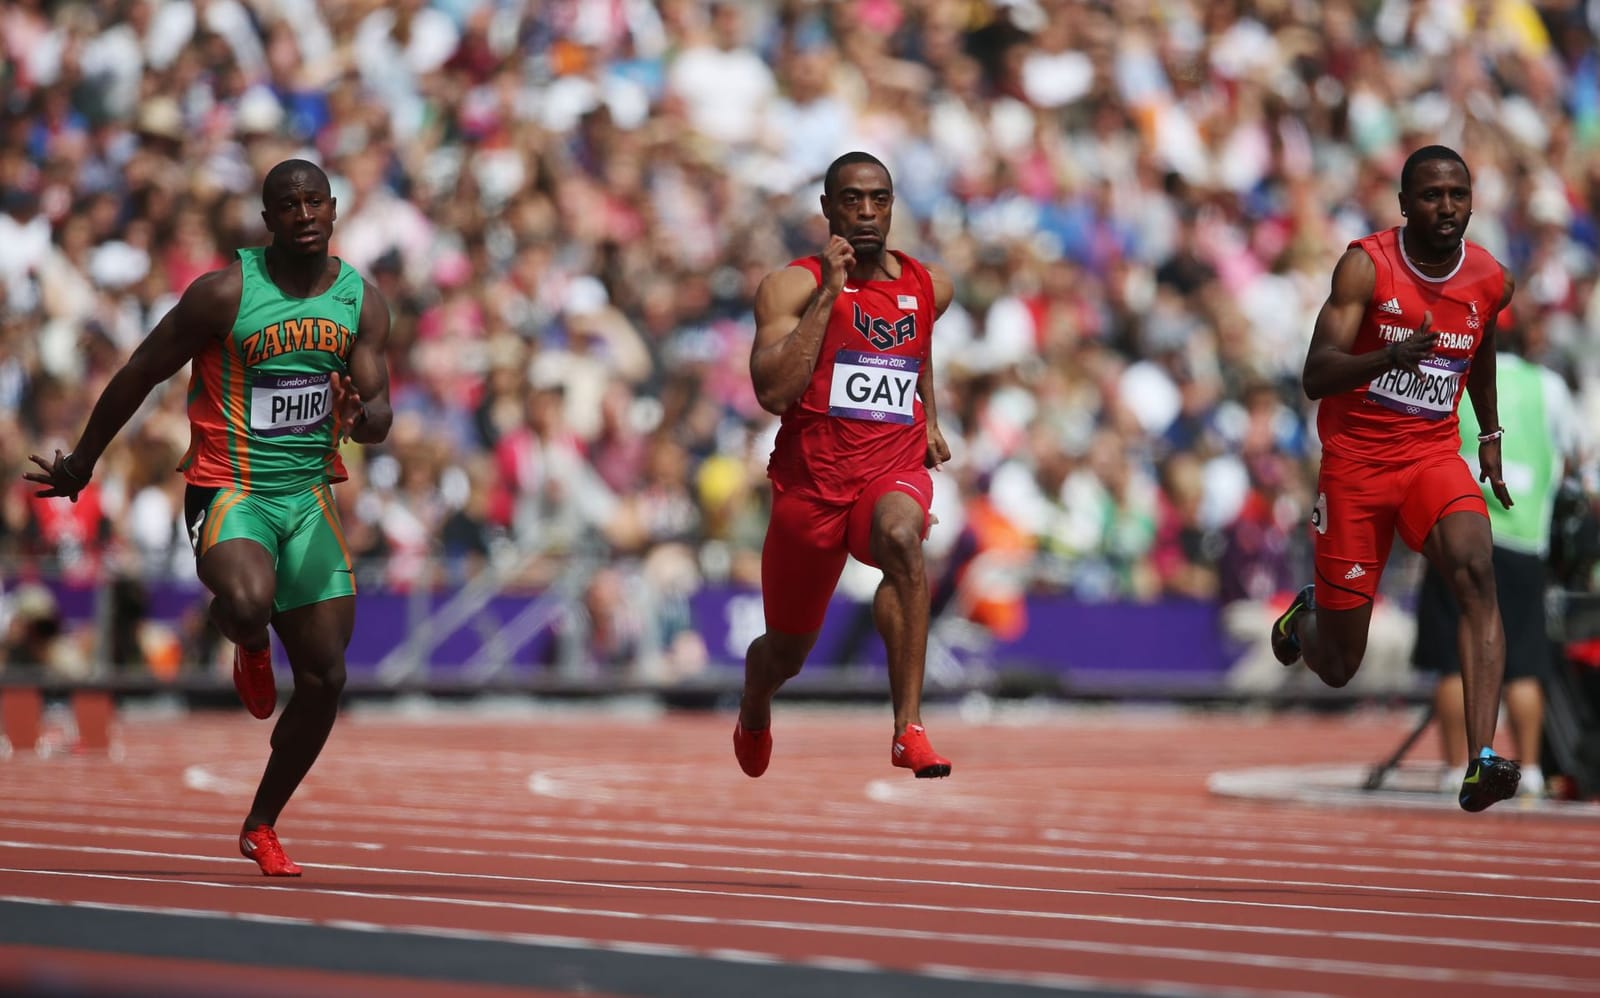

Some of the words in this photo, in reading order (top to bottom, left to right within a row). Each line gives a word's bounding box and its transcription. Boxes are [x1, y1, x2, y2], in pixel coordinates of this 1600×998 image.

[853, 301, 917, 351] USA
[1379, 324, 1414, 343] TRINI
[242, 317, 357, 367] ZAMBI
[858, 354, 888, 366] London
[889, 358, 906, 368] 2012
[1433, 356, 1450, 368] 2012
[277, 377, 308, 387] London
[308, 374, 327, 384] 2012
[845, 372, 912, 407] GAY
[271, 389, 328, 424] PHIRI
